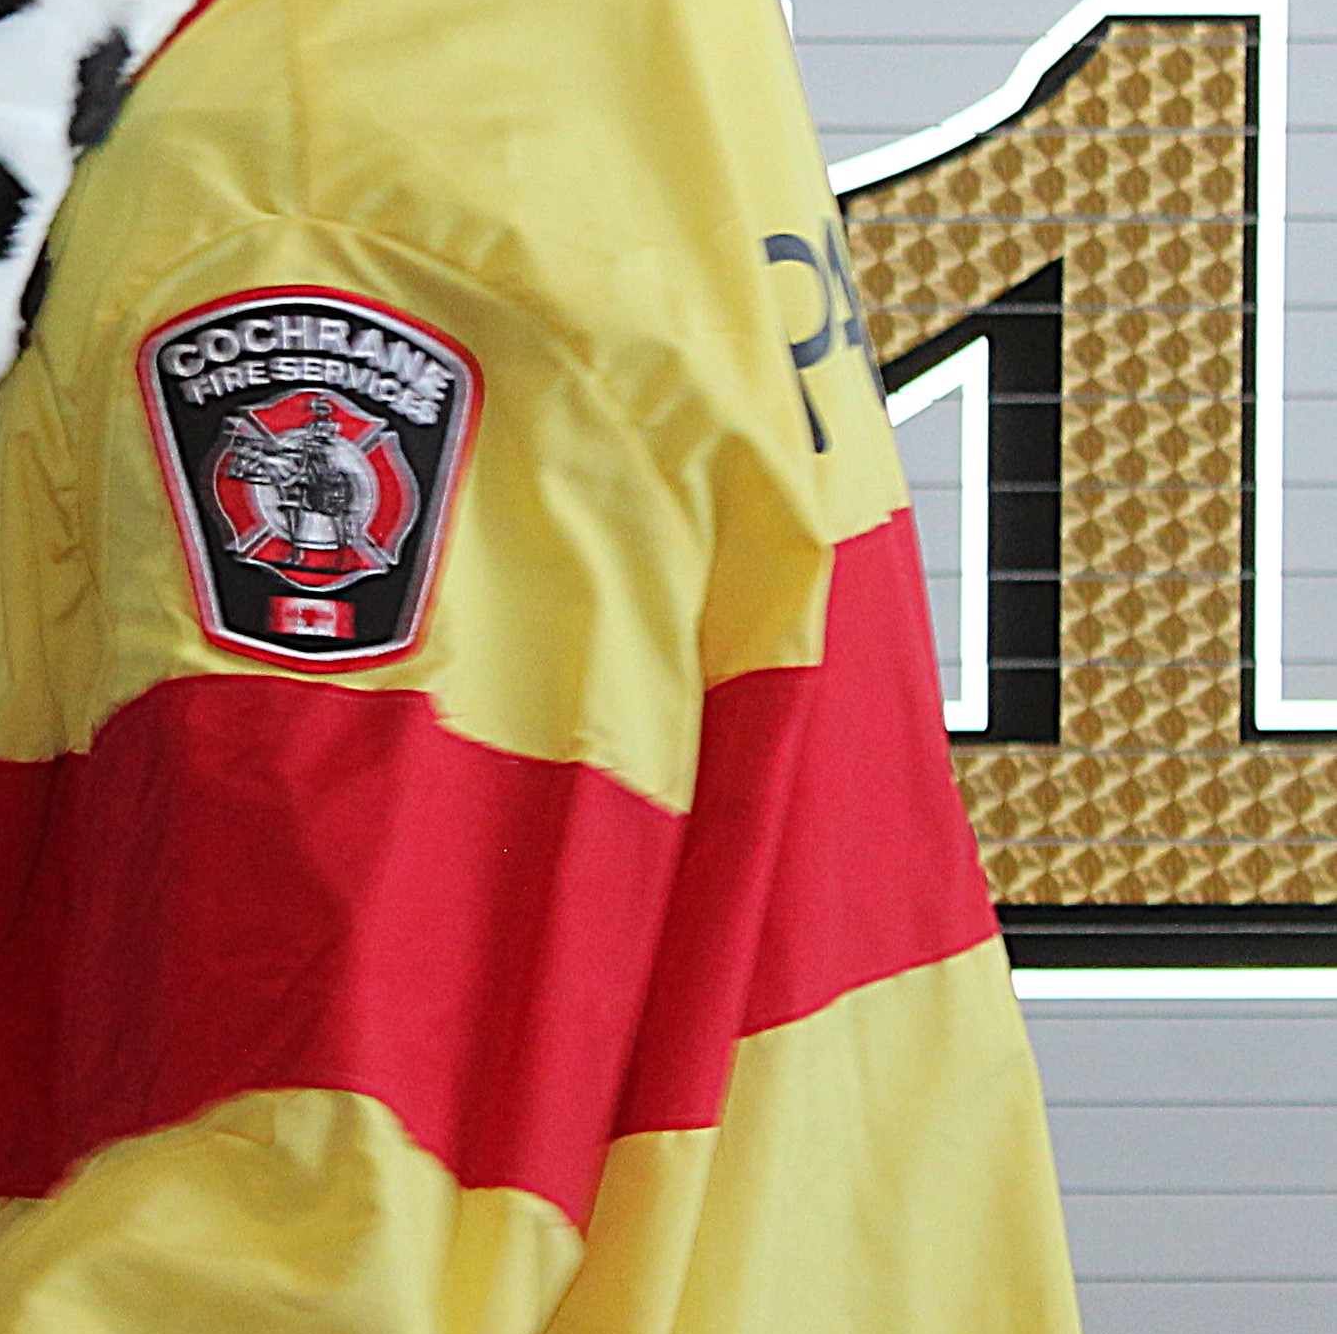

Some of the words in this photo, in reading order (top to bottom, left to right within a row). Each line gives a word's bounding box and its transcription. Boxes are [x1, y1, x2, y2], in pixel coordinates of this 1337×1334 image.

[159, 315, 455, 402] COCHRANE
[182, 359, 271, 405] FIRE
[271, 356, 441, 425] SERVICES
